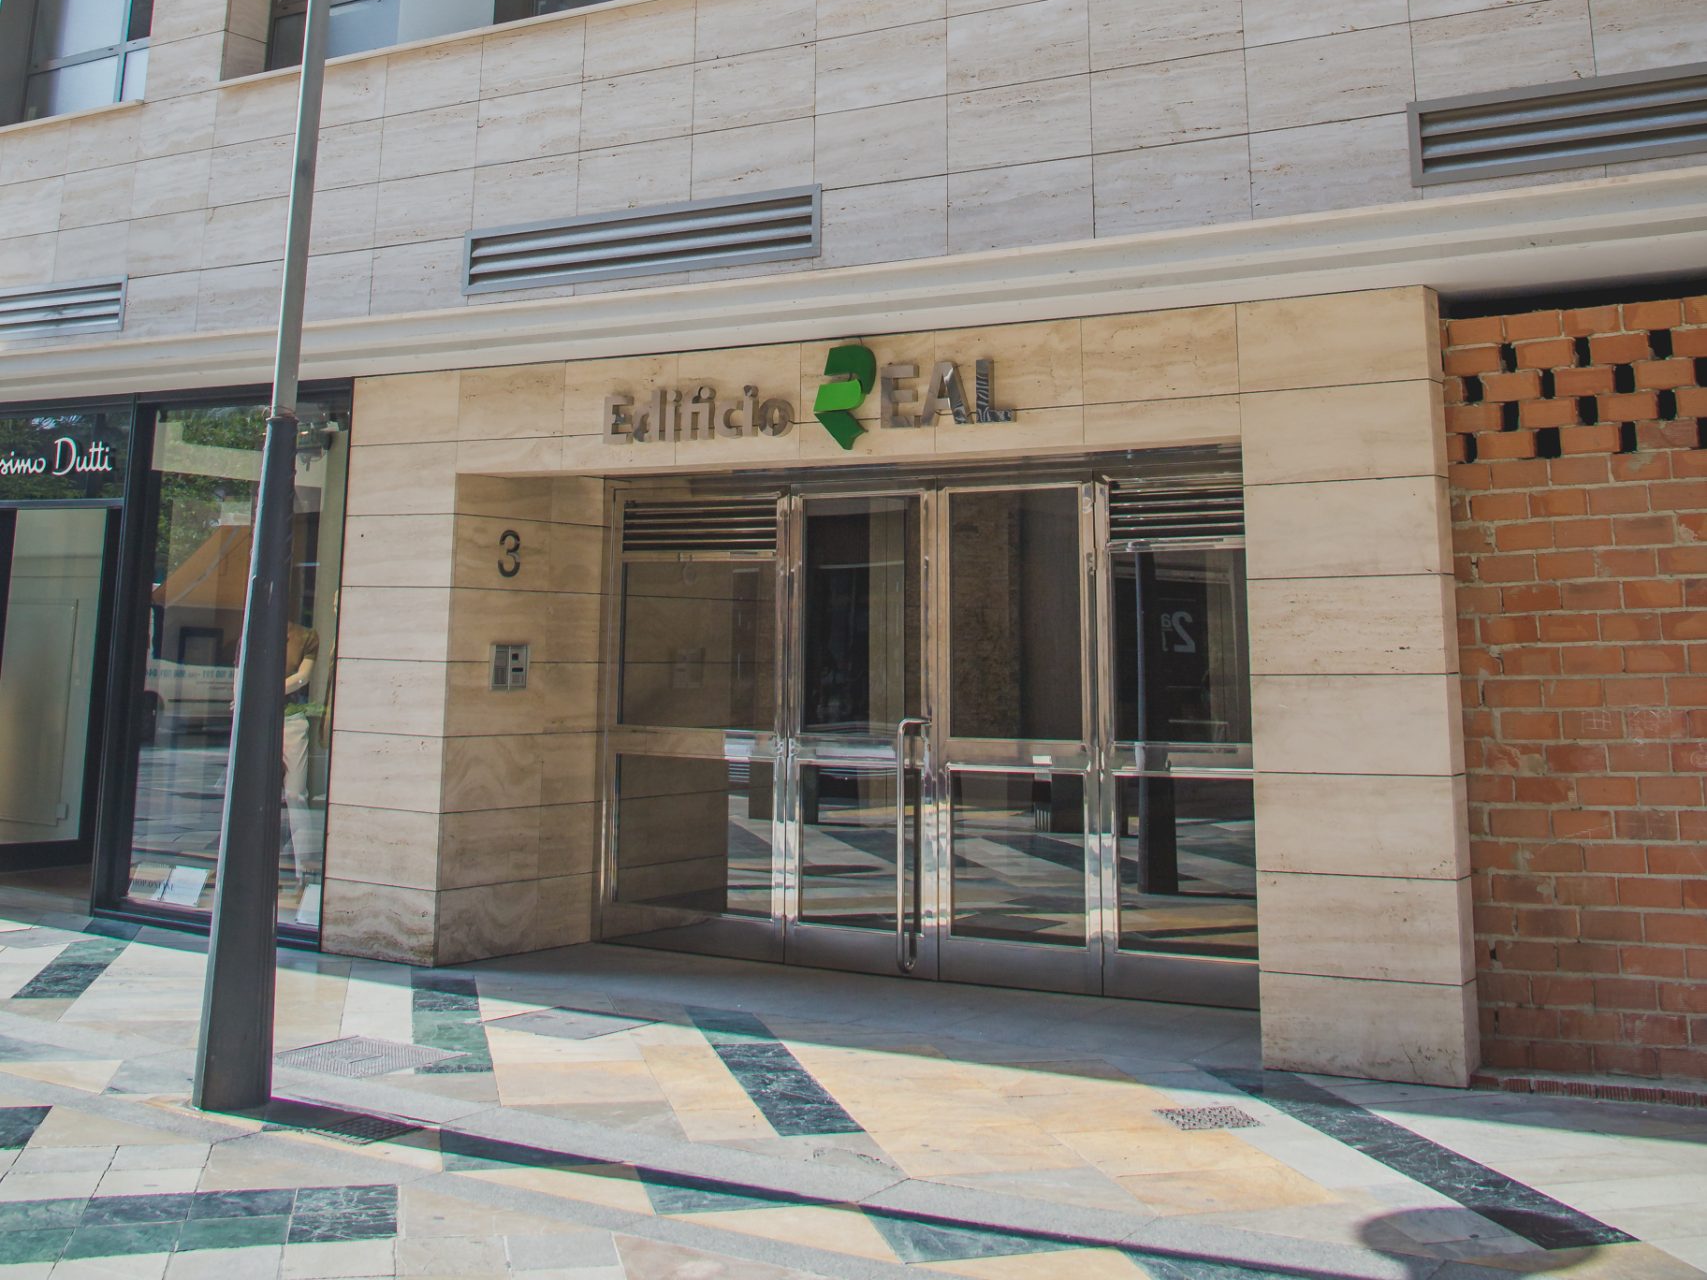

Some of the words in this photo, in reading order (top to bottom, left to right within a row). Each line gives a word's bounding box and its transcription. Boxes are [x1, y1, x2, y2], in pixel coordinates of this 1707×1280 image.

[602, 384, 796, 445] Edificio
[51, 437, 113, 476] Dutti
[497, 529, 521, 578] 3
